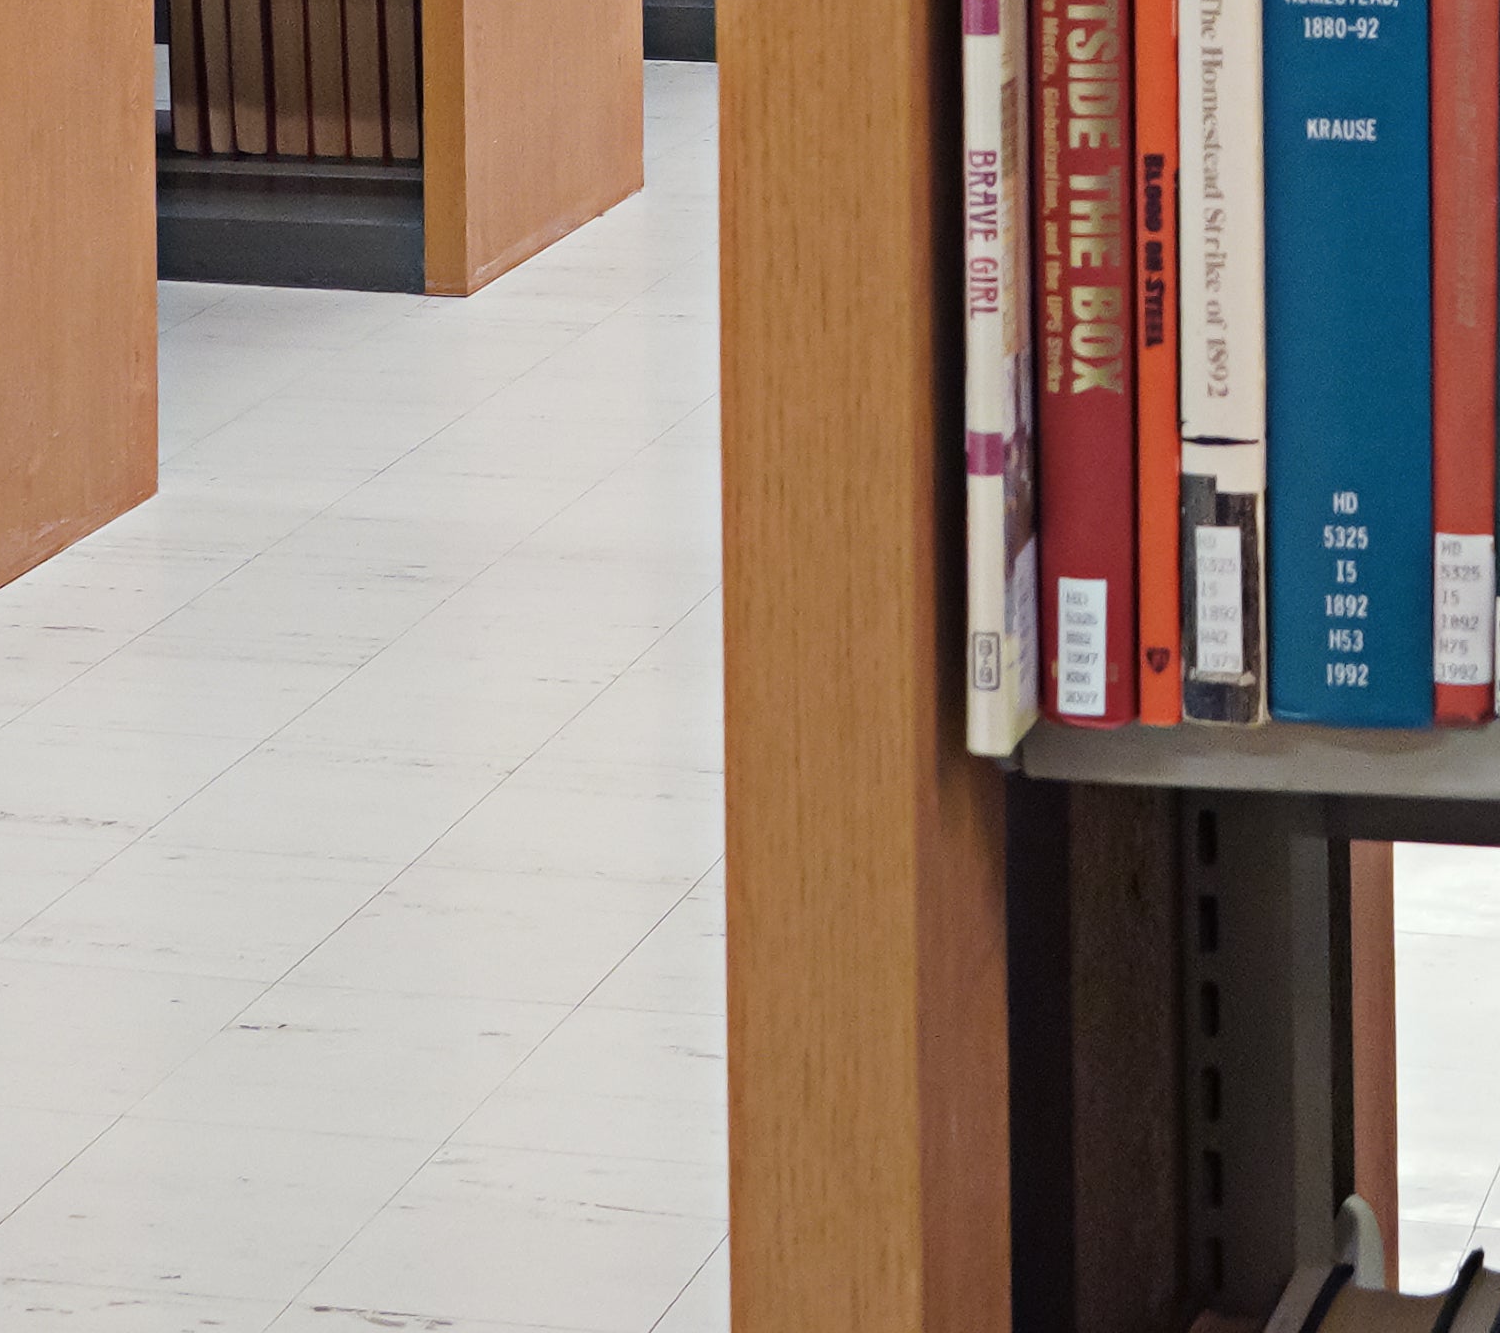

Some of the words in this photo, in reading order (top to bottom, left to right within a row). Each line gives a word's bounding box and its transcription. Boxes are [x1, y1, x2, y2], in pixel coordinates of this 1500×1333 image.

[1303, 17, 1380, 40] 1880-92
[1306, 118, 1377, 141] KRAUSE
[968, 149, 998, 241] BRAVE
[1068, 168, 1123, 270] THE
[969, 250, 999, 320] GIRL
[1070, 286, 1124, 395] BOX
[1332, 491, 1359, 515] HD
[1323, 526, 1369, 550] 5325
[1335, 560, 1358, 583] I5
[1324, 594, 1368, 619] 1892
[1328, 629, 1364, 652] H53
[1325, 662, 1369, 688] 1992
